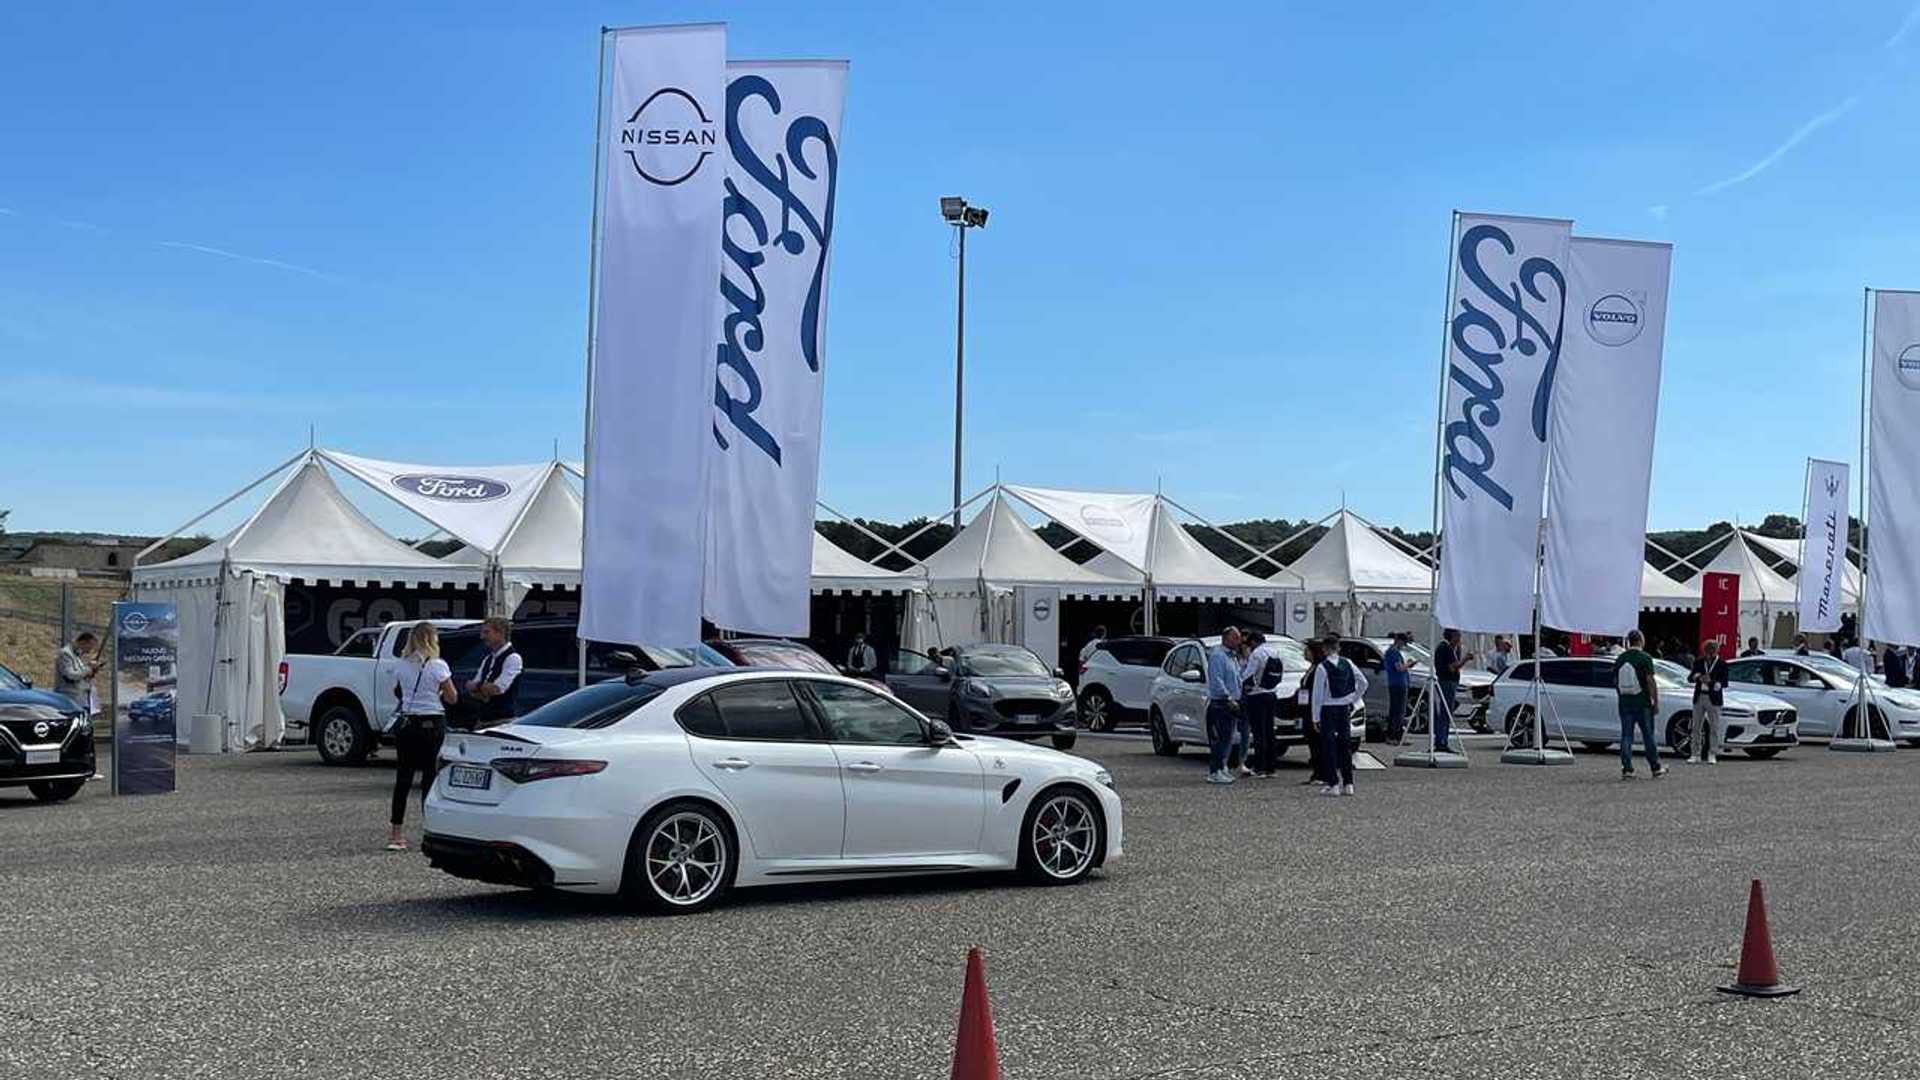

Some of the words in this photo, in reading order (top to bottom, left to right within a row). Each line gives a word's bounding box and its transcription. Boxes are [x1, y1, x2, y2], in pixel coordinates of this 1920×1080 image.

[621, 129, 716, 146] NISSAN
[713, 74, 838, 468] Ford
[1593, 312, 1637, 323] VOLVO
[1442, 224, 1567, 512] Ford
[417, 478, 488, 498] Ford
[1817, 511, 1838, 621] Maserati
